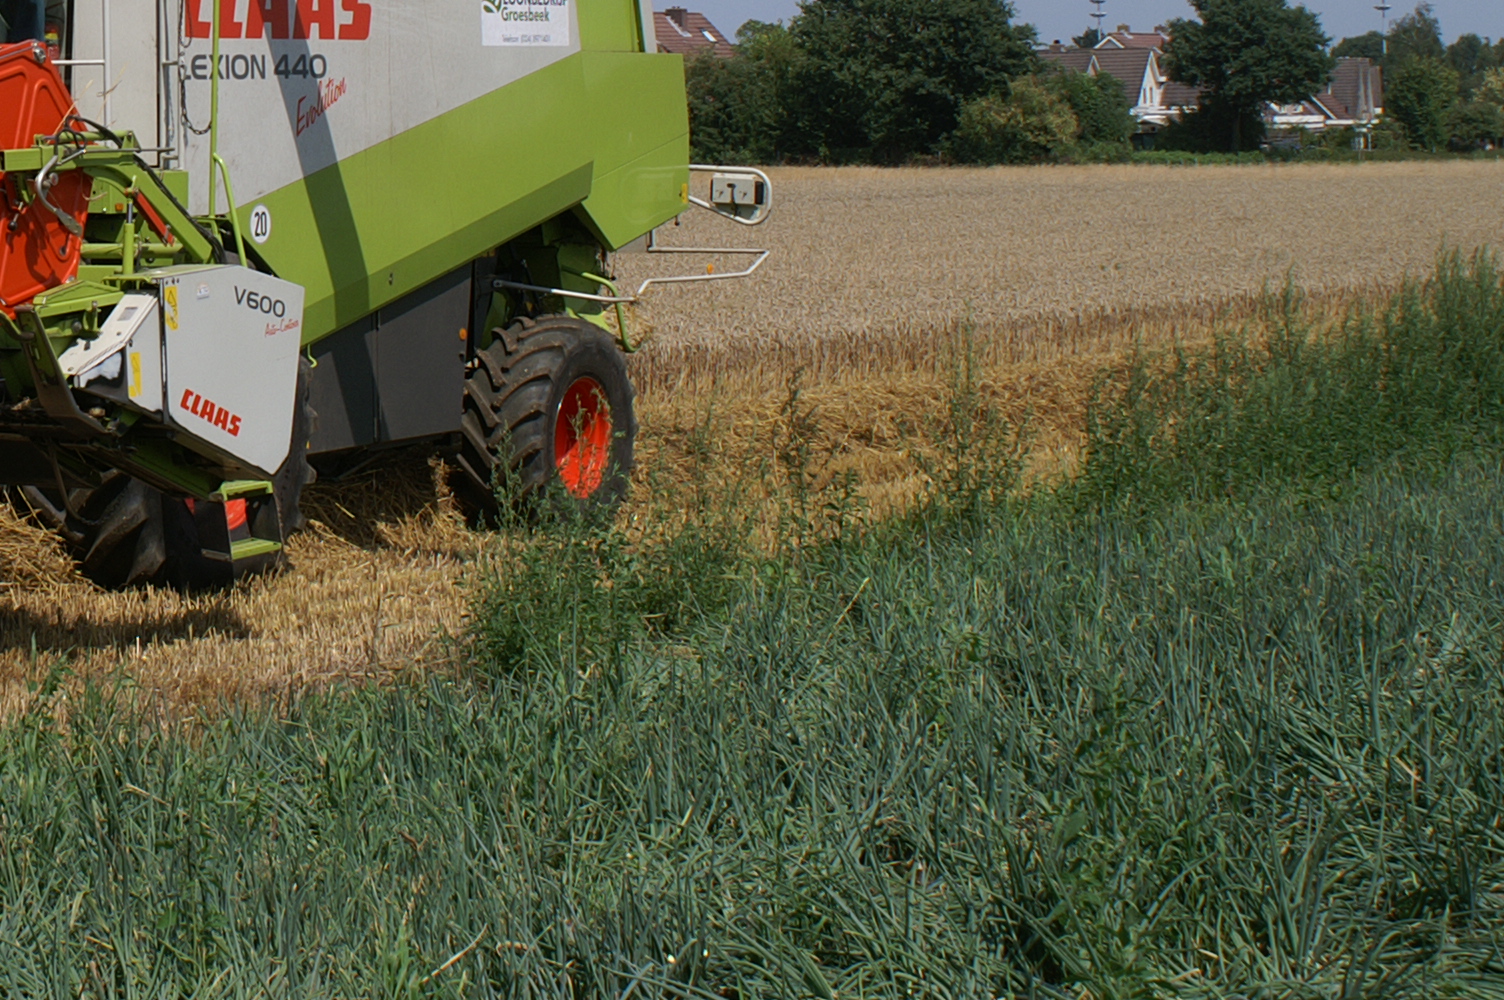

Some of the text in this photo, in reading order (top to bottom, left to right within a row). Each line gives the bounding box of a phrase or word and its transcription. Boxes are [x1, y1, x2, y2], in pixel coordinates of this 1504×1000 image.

[501, 6, 550, 22] Groesbeek
[274, 54, 327, 79] 440
[296, 76, 347, 137] Evolution
[254, 211, 268, 237] 20
[234, 285, 286, 318] V600
[180, 388, 242, 437] CLAAS
